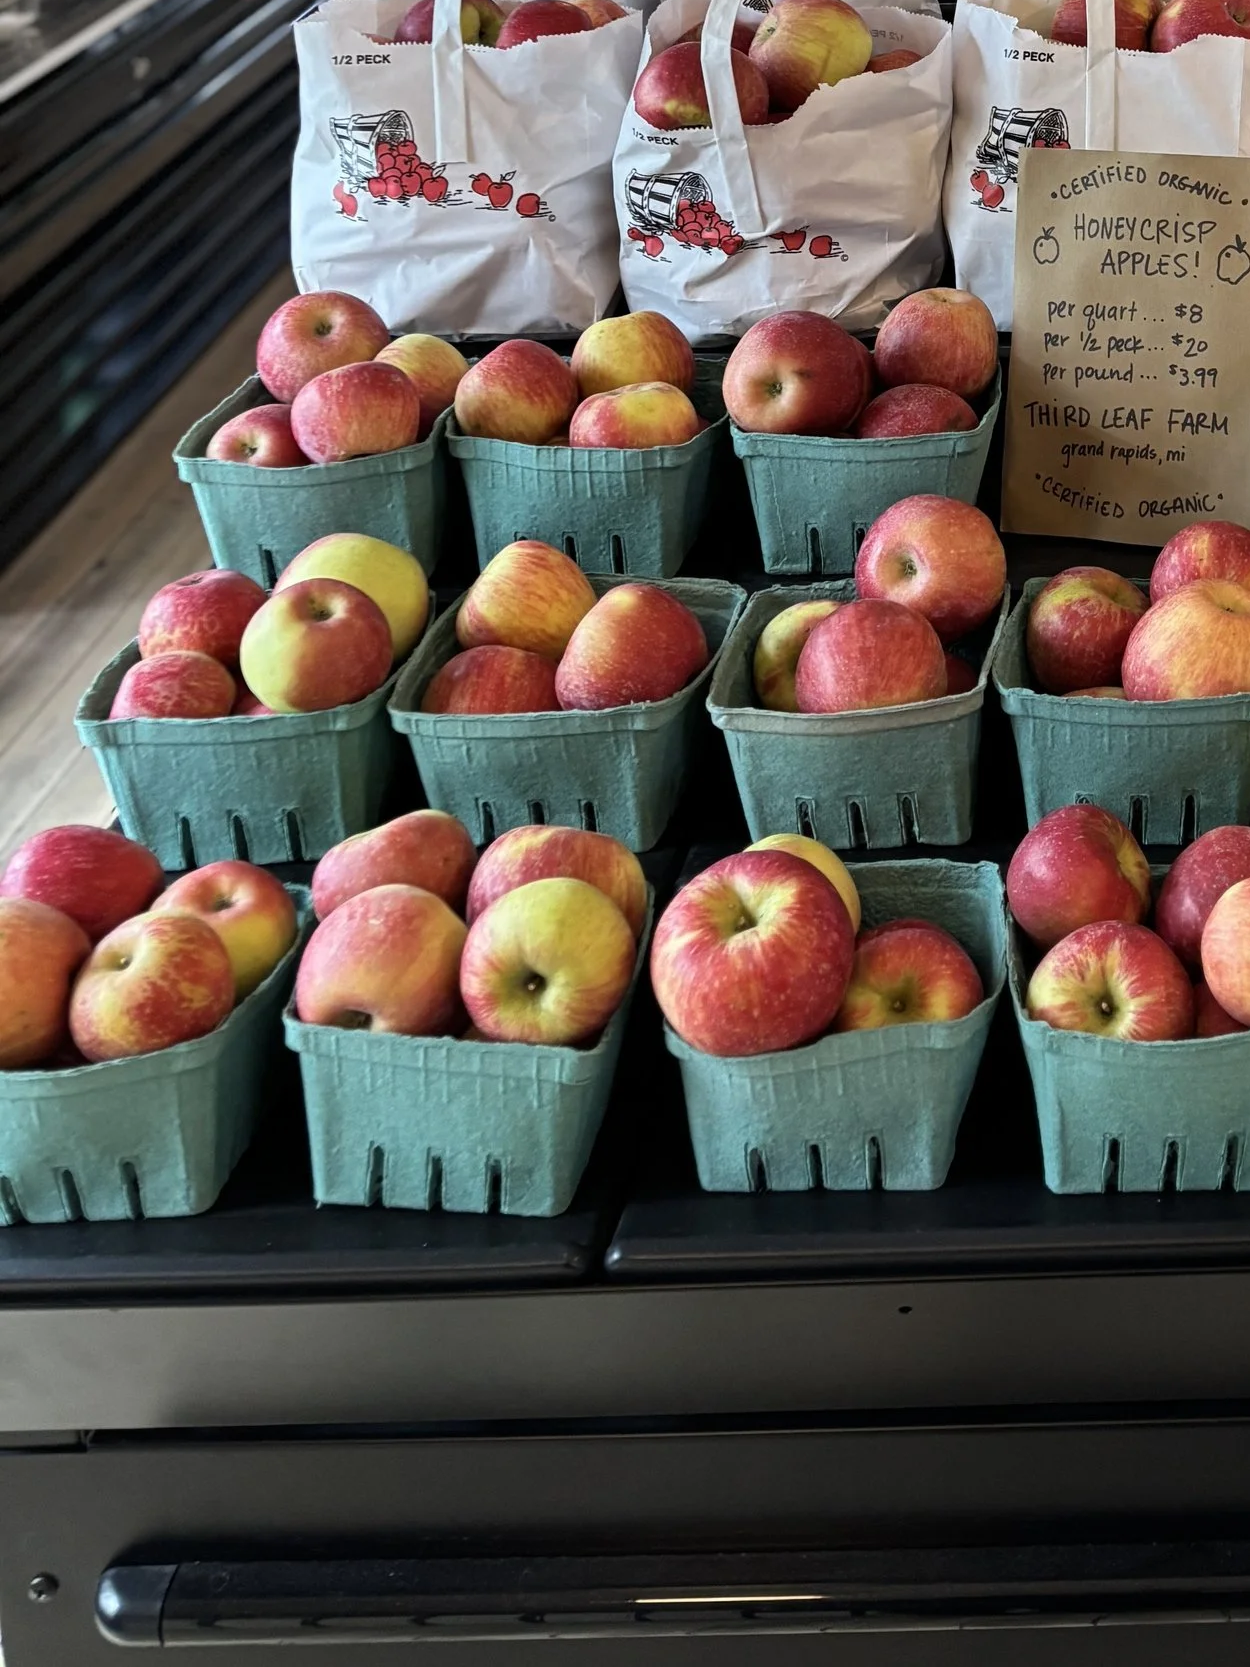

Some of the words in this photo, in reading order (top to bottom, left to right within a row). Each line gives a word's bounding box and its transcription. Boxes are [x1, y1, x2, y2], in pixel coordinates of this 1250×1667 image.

[332, 55, 352, 65] 1/2
[356, 54, 391, 65] PECK
[1004, 49, 1020, 60] 1/2
[1022, 51, 1055, 63] PECK
[632, 127, 645, 141] 1/2
[646, 136, 680, 145] PECK
[1101, 249, 1200, 279] APPLES!
[1048, 302, 1075, 323] per
[1174, 302, 1204, 323] $8
[1043, 332, 1069, 349] per
[1171, 332, 1208, 358] $20
[1043, 362, 1070, 384] per
[1168, 363, 1218, 388] $3.99
[1100, 407, 1154, 431] LEAF
[1167, 409, 1229, 436] FARM
[1061, 441, 1104, 468] grand
[1166, 445, 1186, 462] mi
